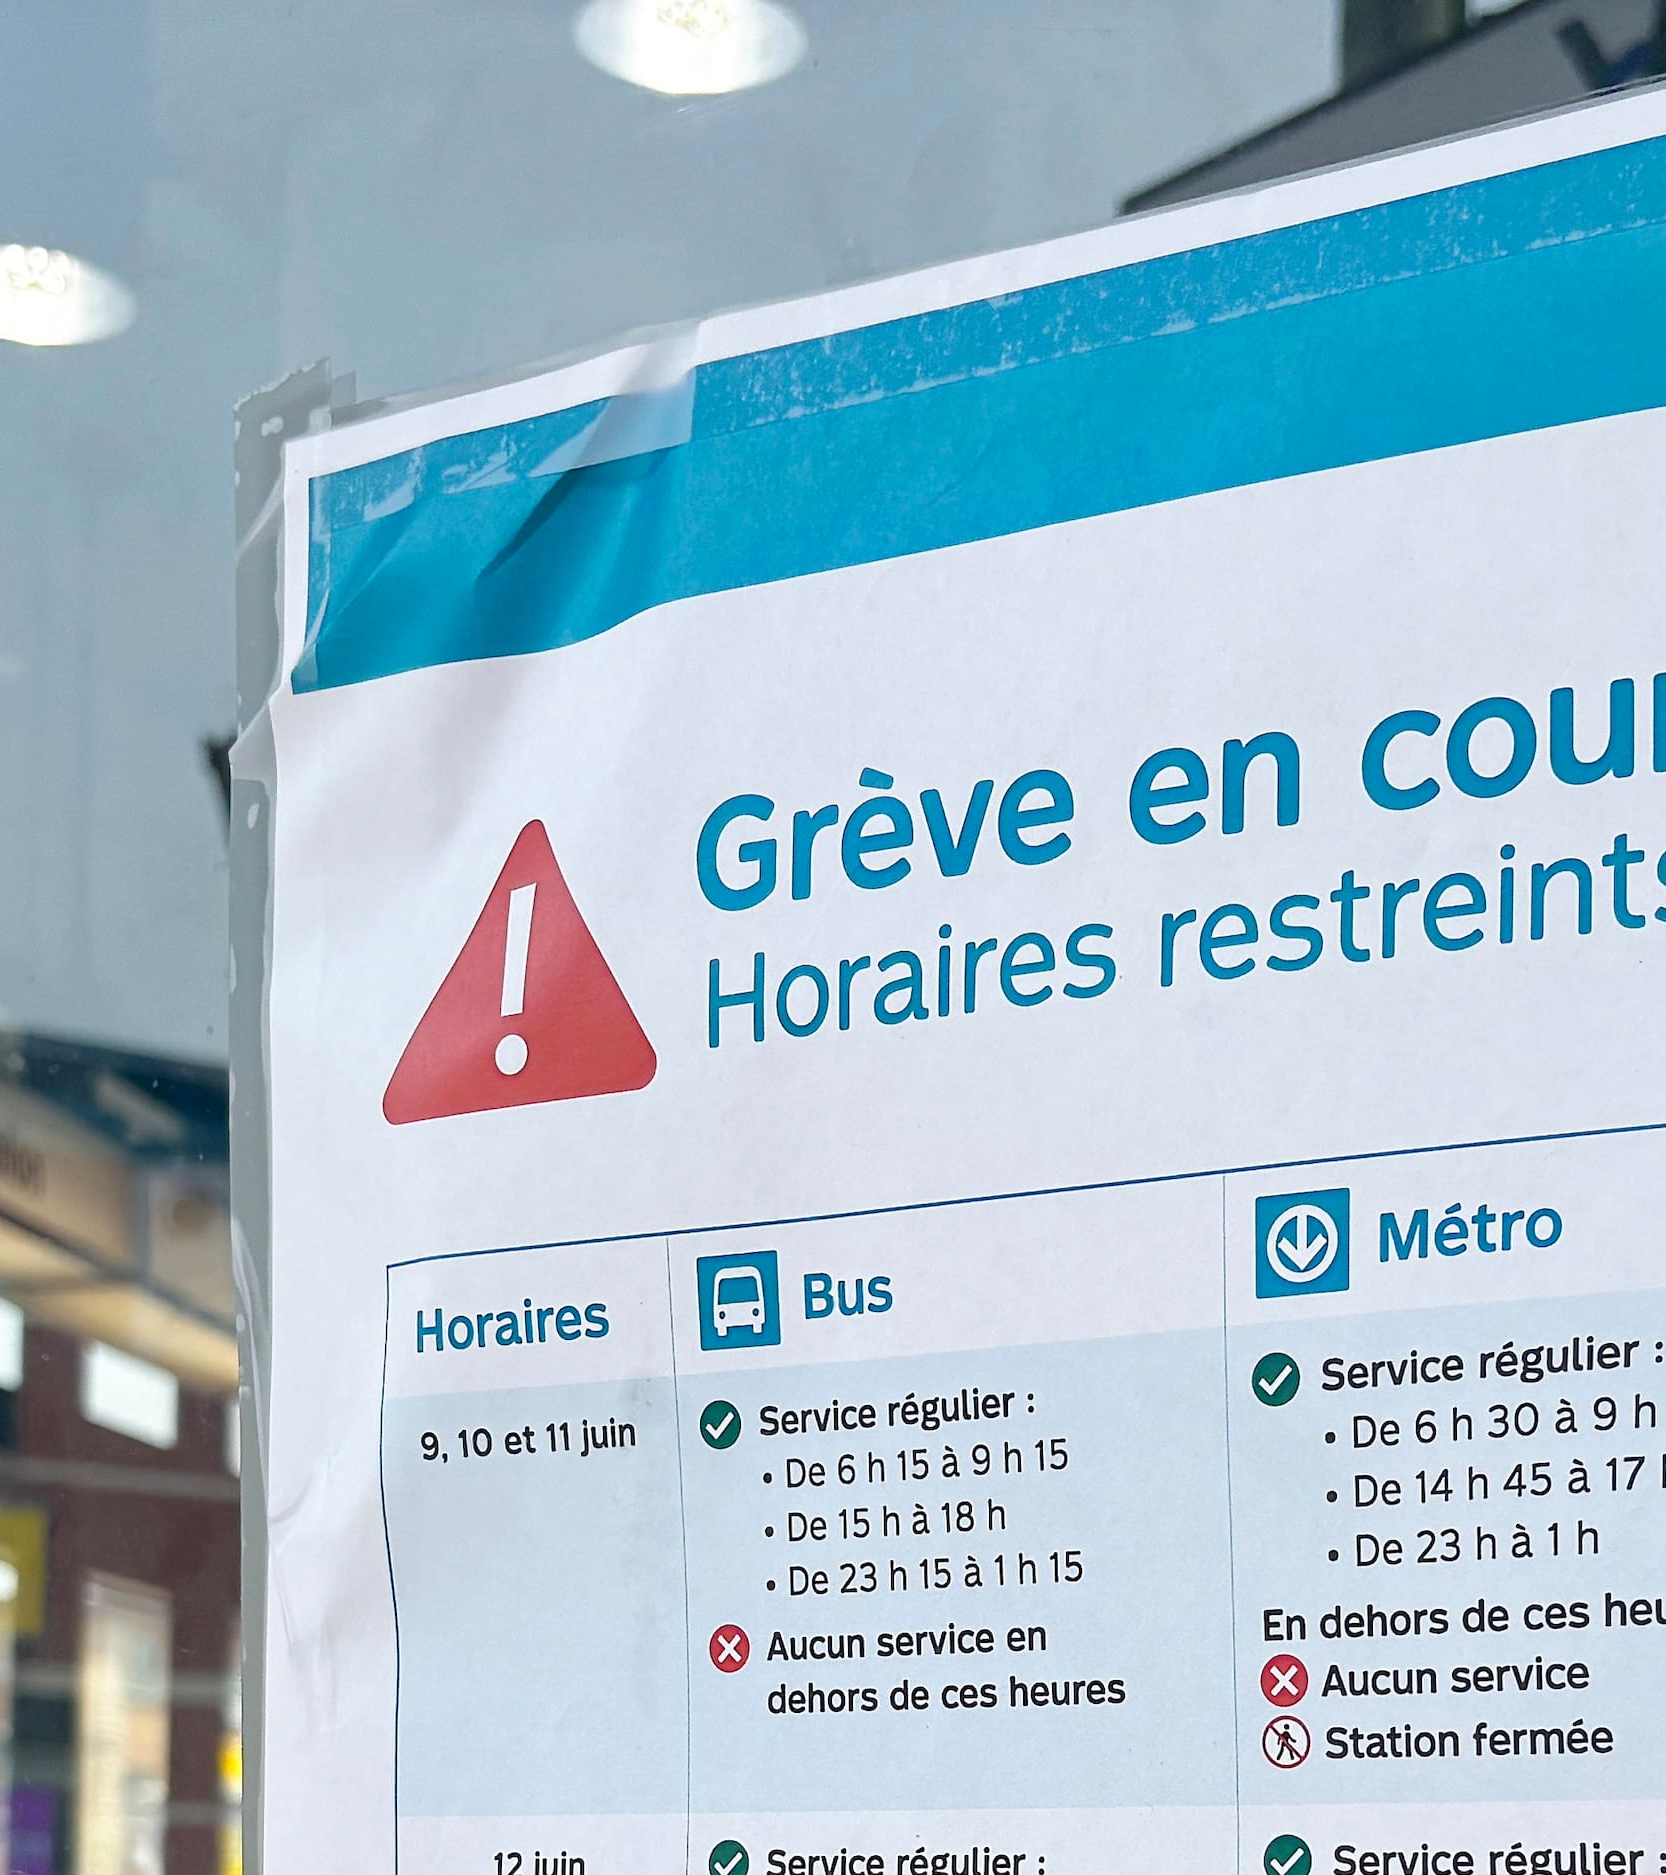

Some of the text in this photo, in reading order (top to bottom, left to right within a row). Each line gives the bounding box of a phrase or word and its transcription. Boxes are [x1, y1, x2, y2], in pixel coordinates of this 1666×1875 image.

[696, 767, 1074, 911] Grève
[1129, 732, 1300, 845] en
[709, 924, 1116, 1048] Horaires
[1380, 1203, 1562, 1263] Métro
[804, 1273, 893, 1320] Bus
[417, 1298, 609, 1353] Horaires
[1322, 1350, 1464, 1391] Service
[1480, 1336, 1639, 1383] régulier
[760, 1400, 876, 1436] Service
[888, 1387, 1015, 1431] régulier
[421, 1417, 635, 1463] 9, 10 et 11 juin
[787, 1438, 1067, 1488] De 6 h 15 à 9 h 15
[767, 1623, 1046, 1661] Aucun service en
[1264, 1609, 1306, 1641] En
[1320, 1604, 1449, 1639] dehors
[1462, 1598, 1509, 1633] de
[1524, 1602, 1590, 1630] ces
[768, 1676, 1125, 1714] dehors de ces heures
[1321, 1656, 1589, 1697] Aucun service
[1326, 1718, 1613, 1759] Station fermée
